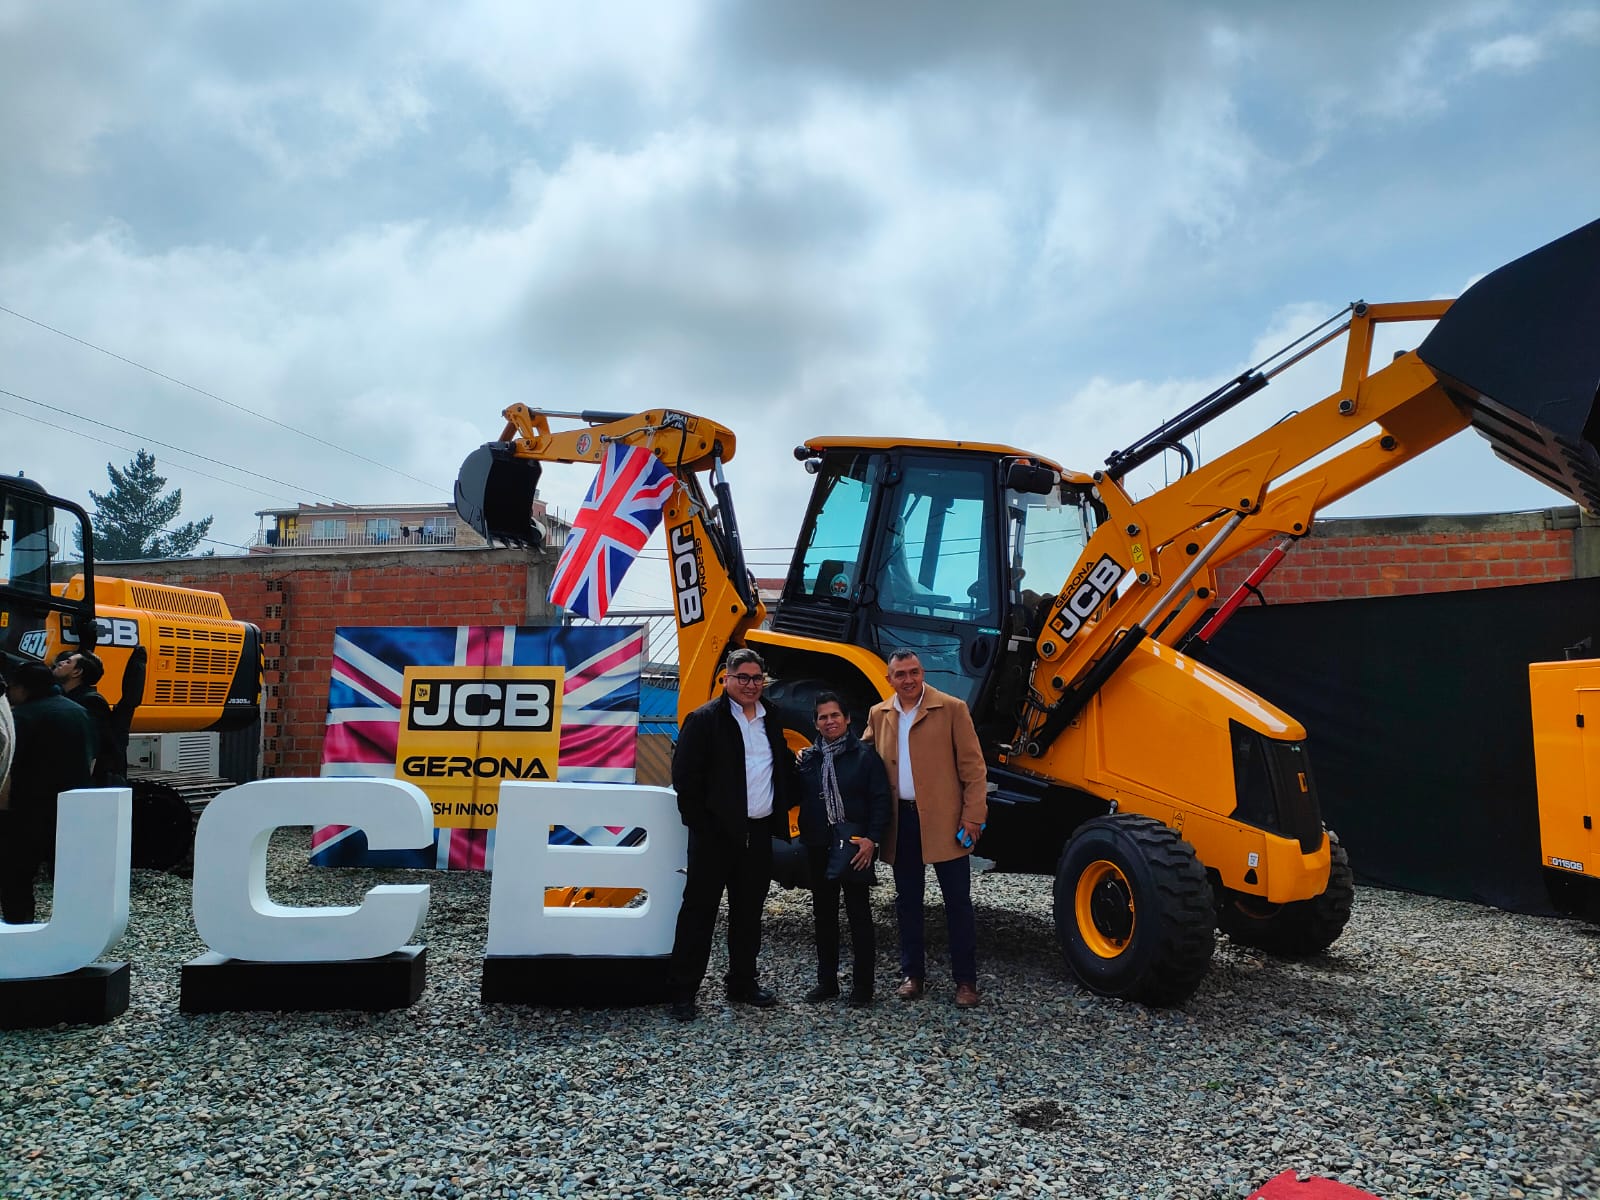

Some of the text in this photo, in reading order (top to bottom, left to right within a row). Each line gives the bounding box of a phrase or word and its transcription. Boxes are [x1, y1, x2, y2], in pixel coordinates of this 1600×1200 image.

[672, 528, 702, 624] JCB
[695, 538, 707, 596] GERONA
[1055, 561, 1094, 608] GERONA
[1060, 558, 1122, 639] JCB
[413, 683, 550, 727] JCB
[403, 756, 549, 778] GERONA
[0, 777, 688, 978] JCB
